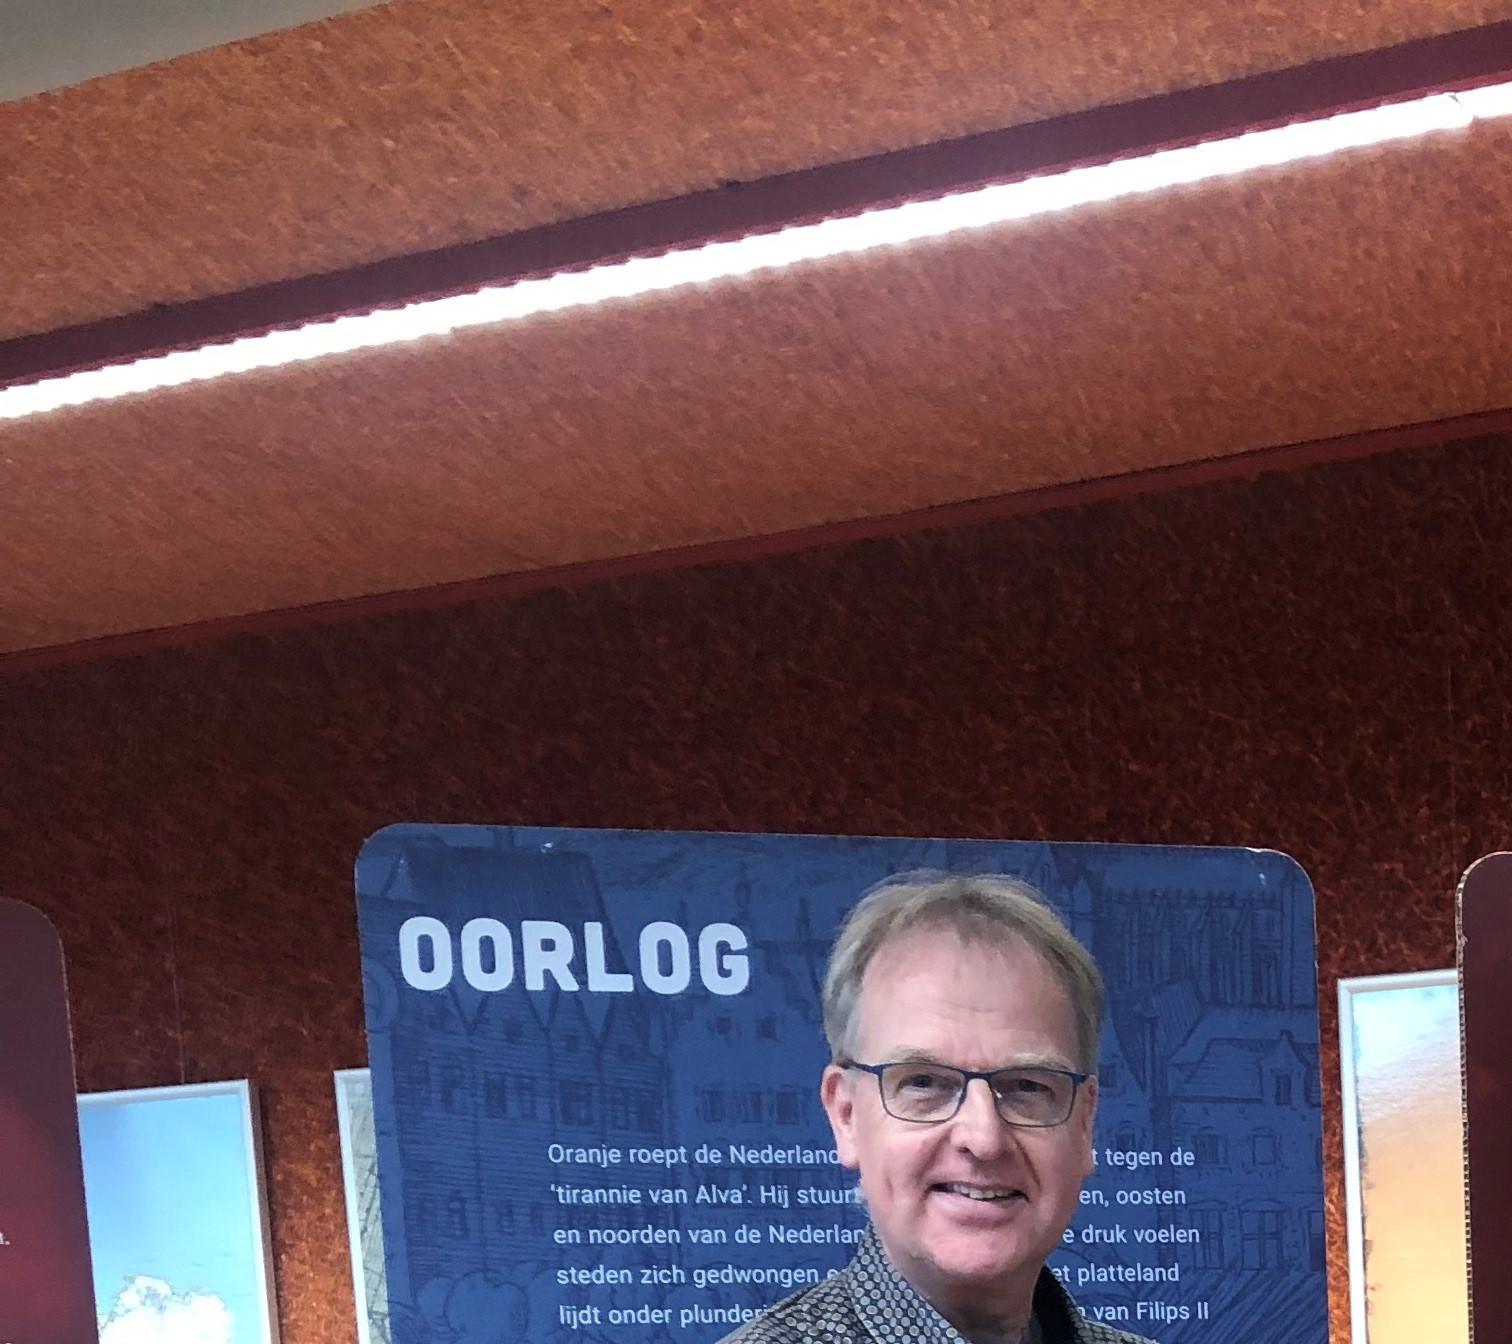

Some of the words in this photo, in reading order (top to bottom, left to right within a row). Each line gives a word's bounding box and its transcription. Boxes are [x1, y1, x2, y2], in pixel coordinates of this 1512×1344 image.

[399, 917, 750, 996] OORLOG
[548, 1144, 622, 1168] Oranje
[629, 1146, 687, 1168] roept
[693, 1144, 722, 1165] de
[729, 1145, 839, 1166] Nederland
[1105, 1148, 1162, 1170] tegen
[1170, 1146, 1195, 1166] de
[649, 1189, 688, 1205] van
[760, 1185, 789, 1209] Hij
[1116, 1188, 1186, 1205] oosten
[554, 1229, 581, 1244] en
[589, 1224, 680, 1245] noorden
[688, 1228, 727, 1244] van
[735, 1224, 761, 1244] de
[769, 1223, 865, 1244] Nederlan
[1082, 1224, 1127, 1244] druk
[1134, 1224, 1199, 1243] voelen
[557, 1264, 633, 1285] steden
[640, 1264, 685, 1284] zich
[693, 1264, 819, 1289] gedwongen
[1078, 1262, 1180, 1287] platteland
[560, 1304, 601, 1329] lijdt
[609, 1304, 672, 1324] onder
[1094, 1306, 1129, 1320] van
[1137, 1301, 1190, 1324] Filips
[1198, 1301, 1209, 1320] II
